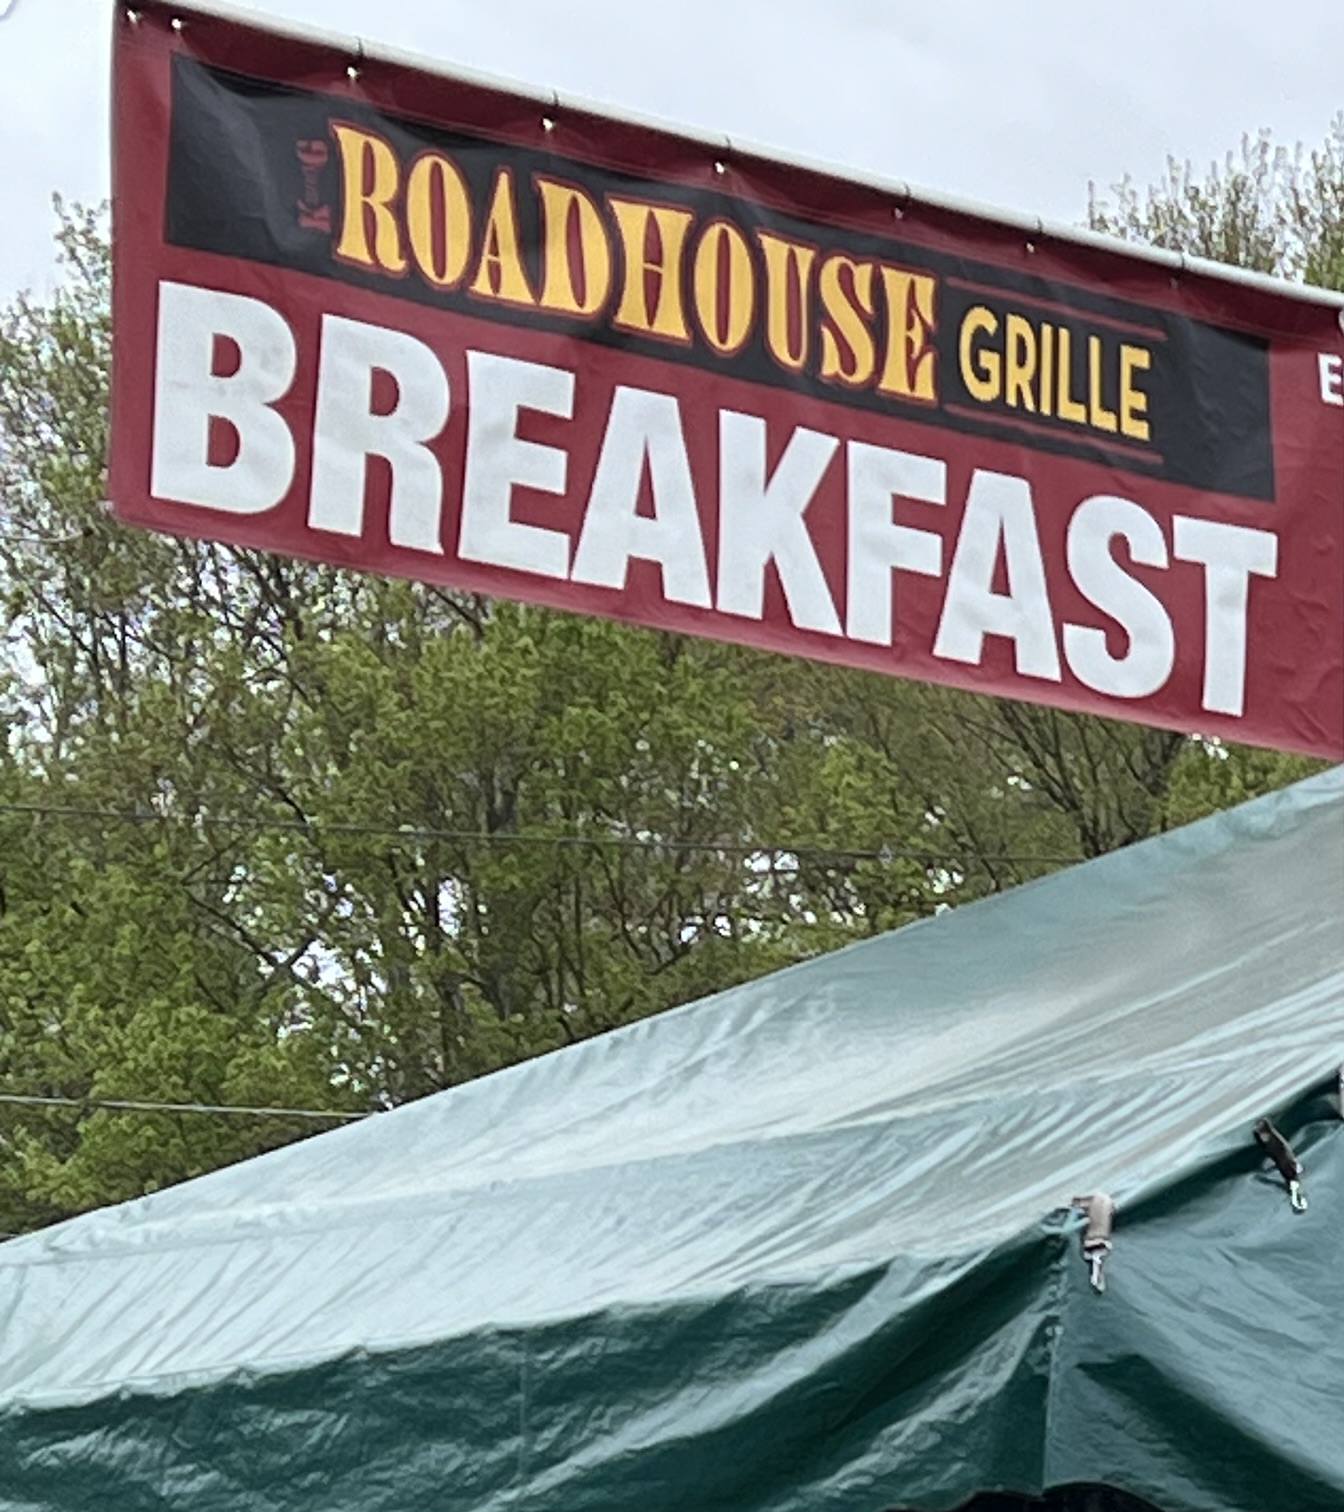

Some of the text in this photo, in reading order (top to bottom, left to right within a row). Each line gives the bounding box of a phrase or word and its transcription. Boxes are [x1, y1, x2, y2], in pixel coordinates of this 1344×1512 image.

[330, 120, 1151, 441] ROADHOUSE GRILLE
[151, 280, 1277, 717] BREAKFAST
